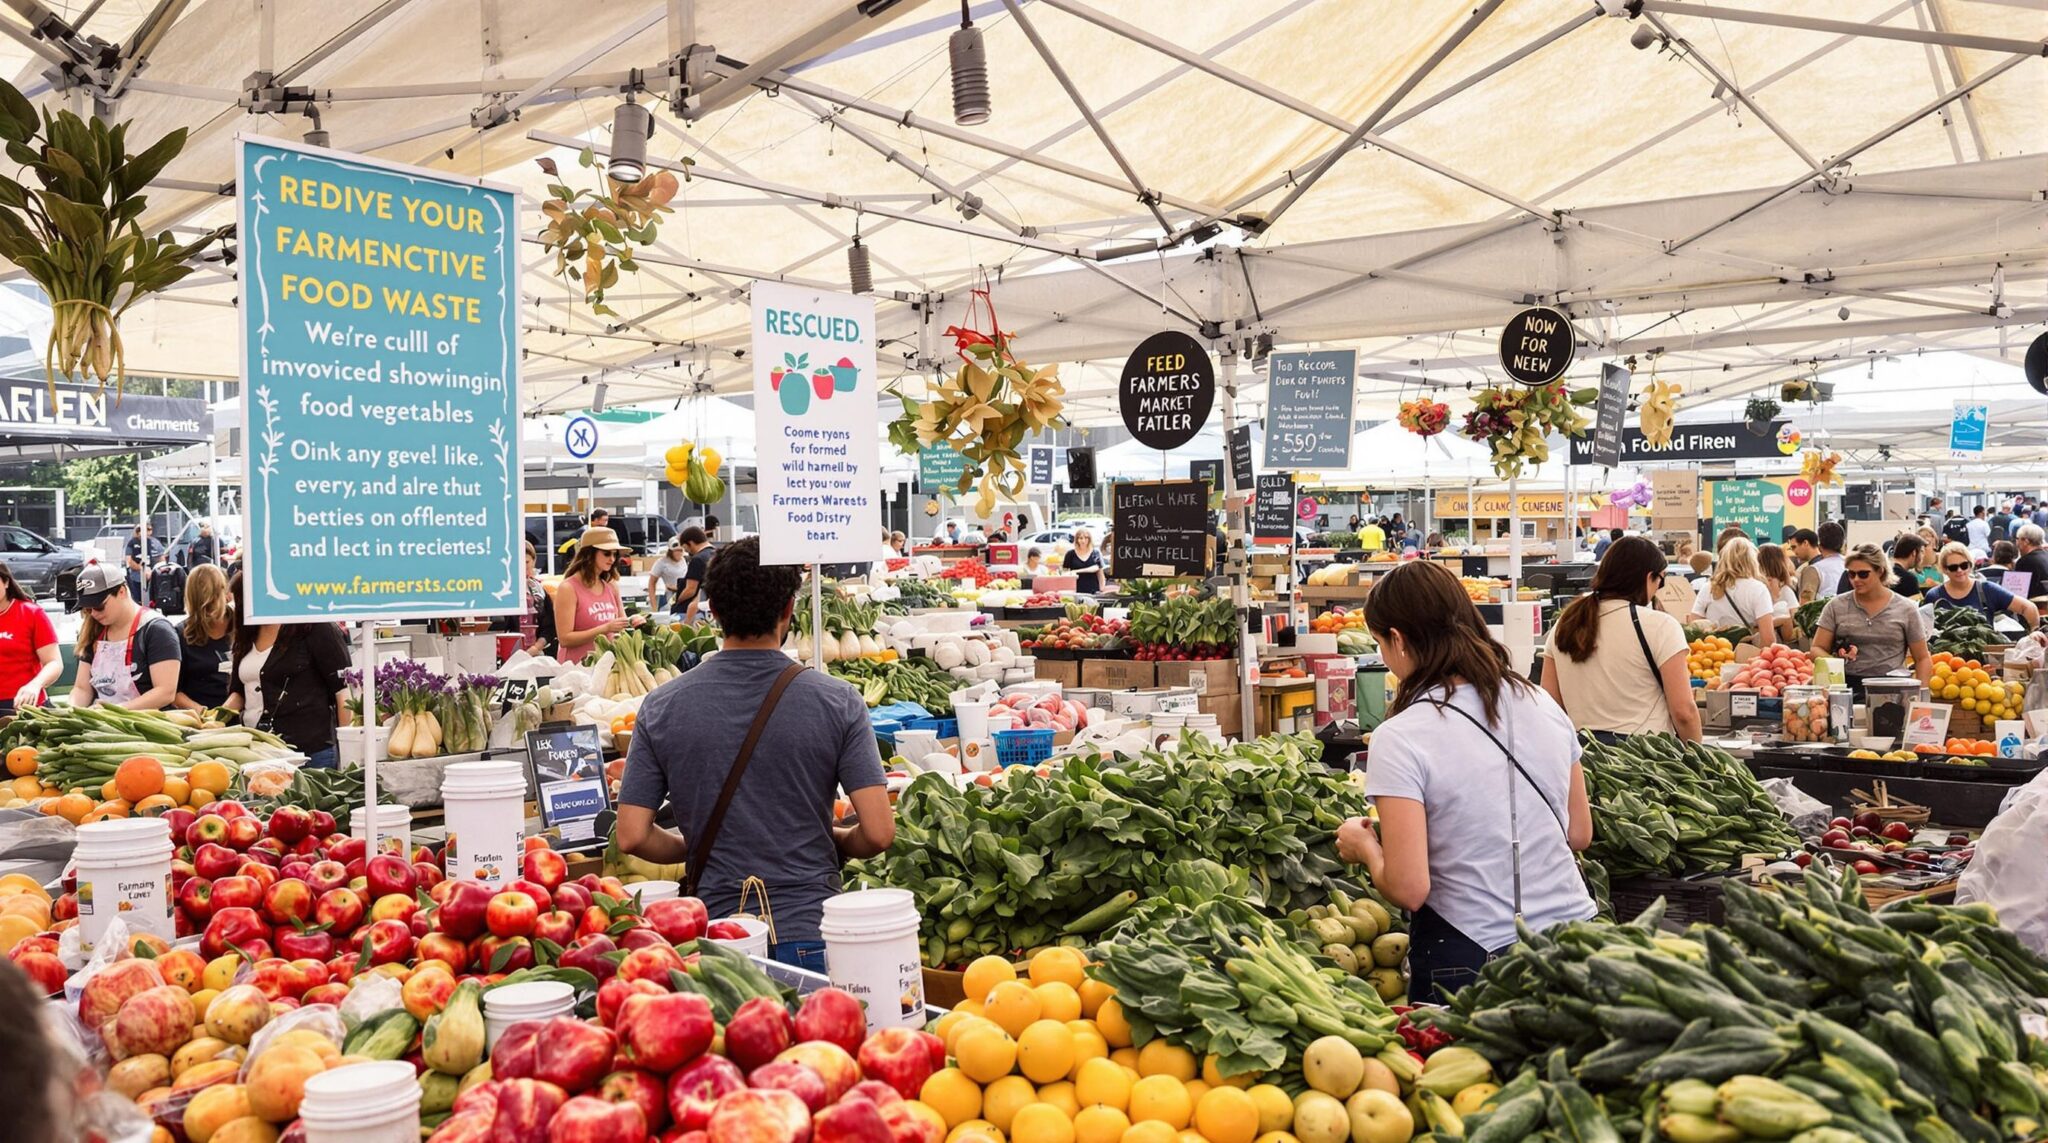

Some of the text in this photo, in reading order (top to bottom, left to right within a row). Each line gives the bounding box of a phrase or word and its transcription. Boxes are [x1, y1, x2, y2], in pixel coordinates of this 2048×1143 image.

[280, 175, 485, 234] REDIVE YOUR
[276, 226, 486, 281] FARMENCTIVE
[281, 274, 481, 324] FOOD WASTE
[1525, 316, 1557, 335] NOW
[436, 334, 460, 355] of
[1521, 336, 1548, 353] FOR
[1147, 354, 1185, 372] FEED
[1514, 355, 1552, 373] NEEW
[1130, 373, 1200, 394] FARMERS
[300, 392, 474, 426] food vegetables
[1139, 395, 1195, 413] MARKET
[784, 426, 820, 438] Coome
[1137, 414, 1191, 432] FATLER
[290, 439, 341, 462] Oink
[347, 448, 381, 468] any
[444, 446, 483, 466] like.
[790, 442, 847, 455] for formed
[782, 460, 804, 472] wild
[846, 462, 858, 475] by
[295, 479, 357, 499] every,
[361, 475, 397, 496] and
[443, 475, 482, 497] thut
[773, 494, 819, 506] Farmers
[293, 505, 364, 527] betties
[370, 511, 396, 527] on
[788, 512, 813, 522] Food
[289, 537, 326, 558] and
[333, 536, 371, 557] lect
[375, 539, 393, 557] in
[296, 575, 484, 597] www.farmersts.com
